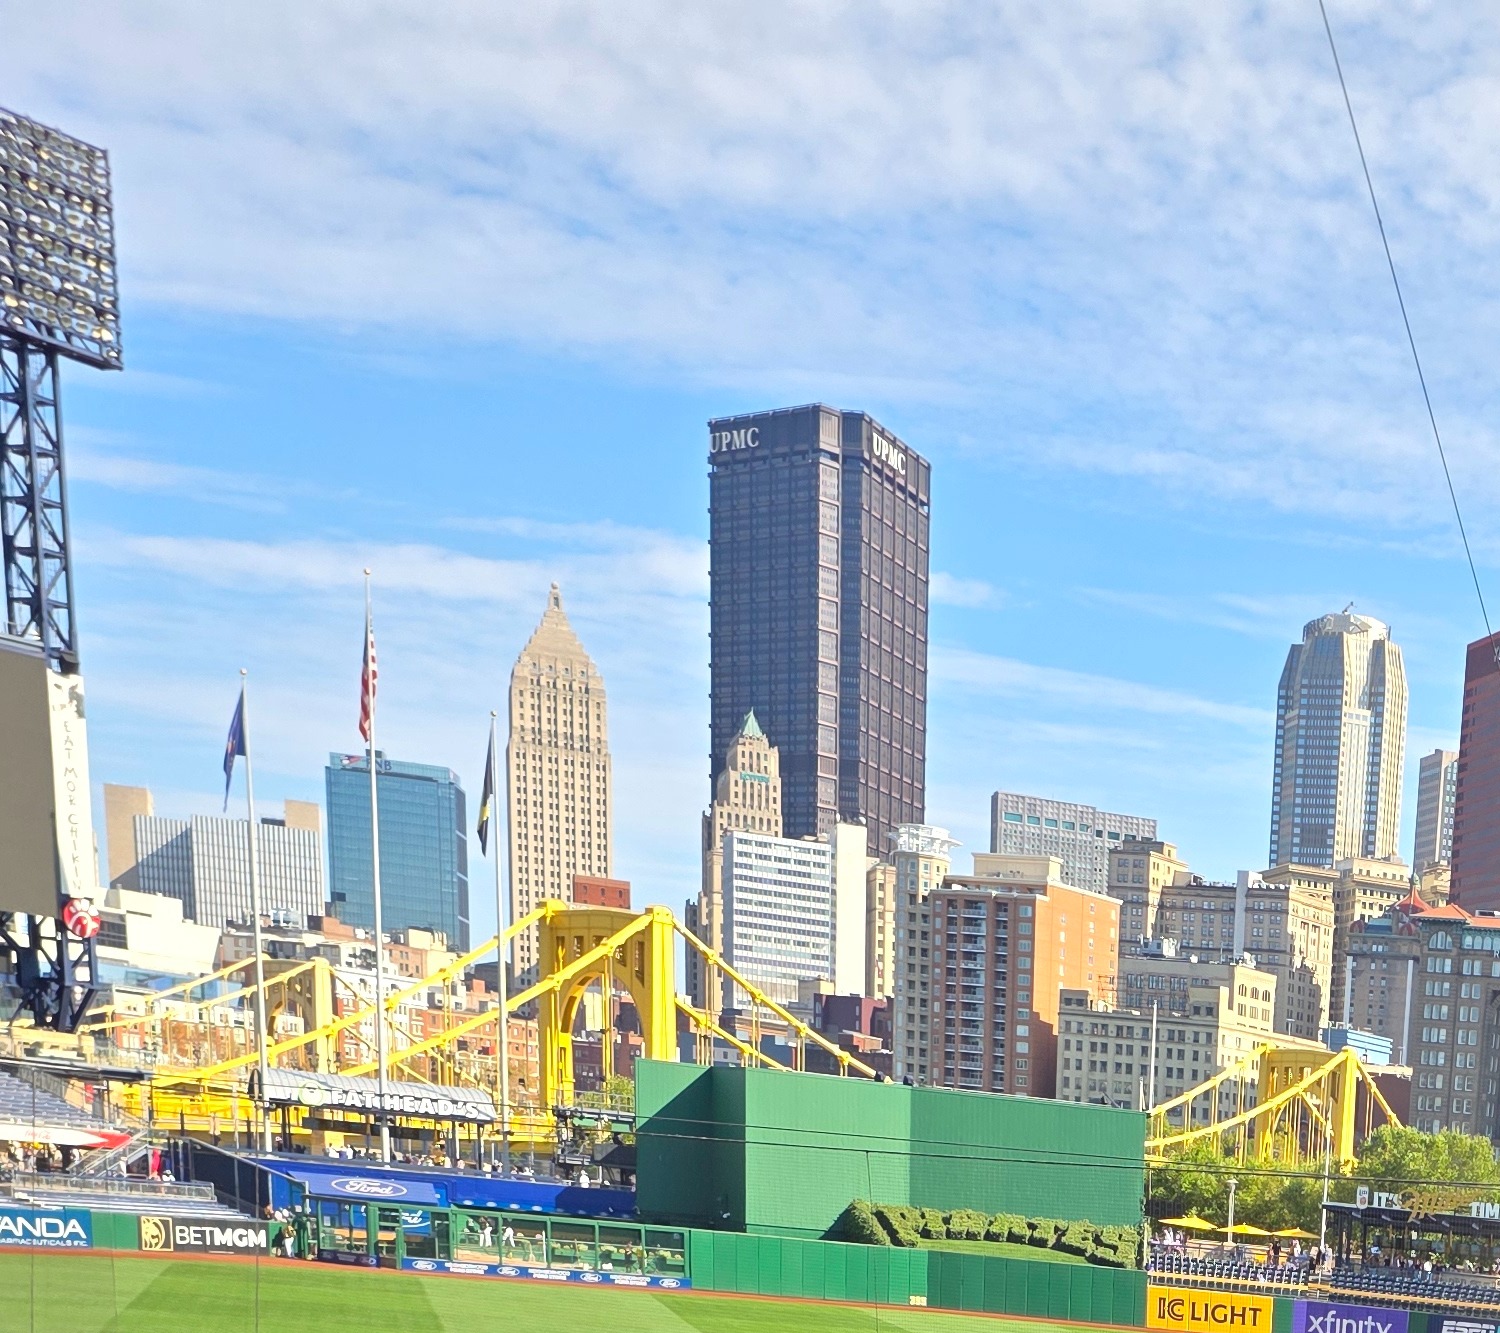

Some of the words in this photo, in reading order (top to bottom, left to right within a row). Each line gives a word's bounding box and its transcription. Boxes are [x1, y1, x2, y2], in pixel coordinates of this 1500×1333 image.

[709, 427, 760, 453] UPMC
[872, 432, 906, 475] UPMC
[63, 766, 78, 807] MOR
[331, 1087, 378, 1109] FAT
[385, 1093, 480, 1120] HEAD'S
[345, 1178, 394, 1196] Ford
[0, 1213, 87, 1240] ANDA
[175, 1225, 267, 1248] BETMGM
[1190, 1301, 1262, 1327] LIGHT
